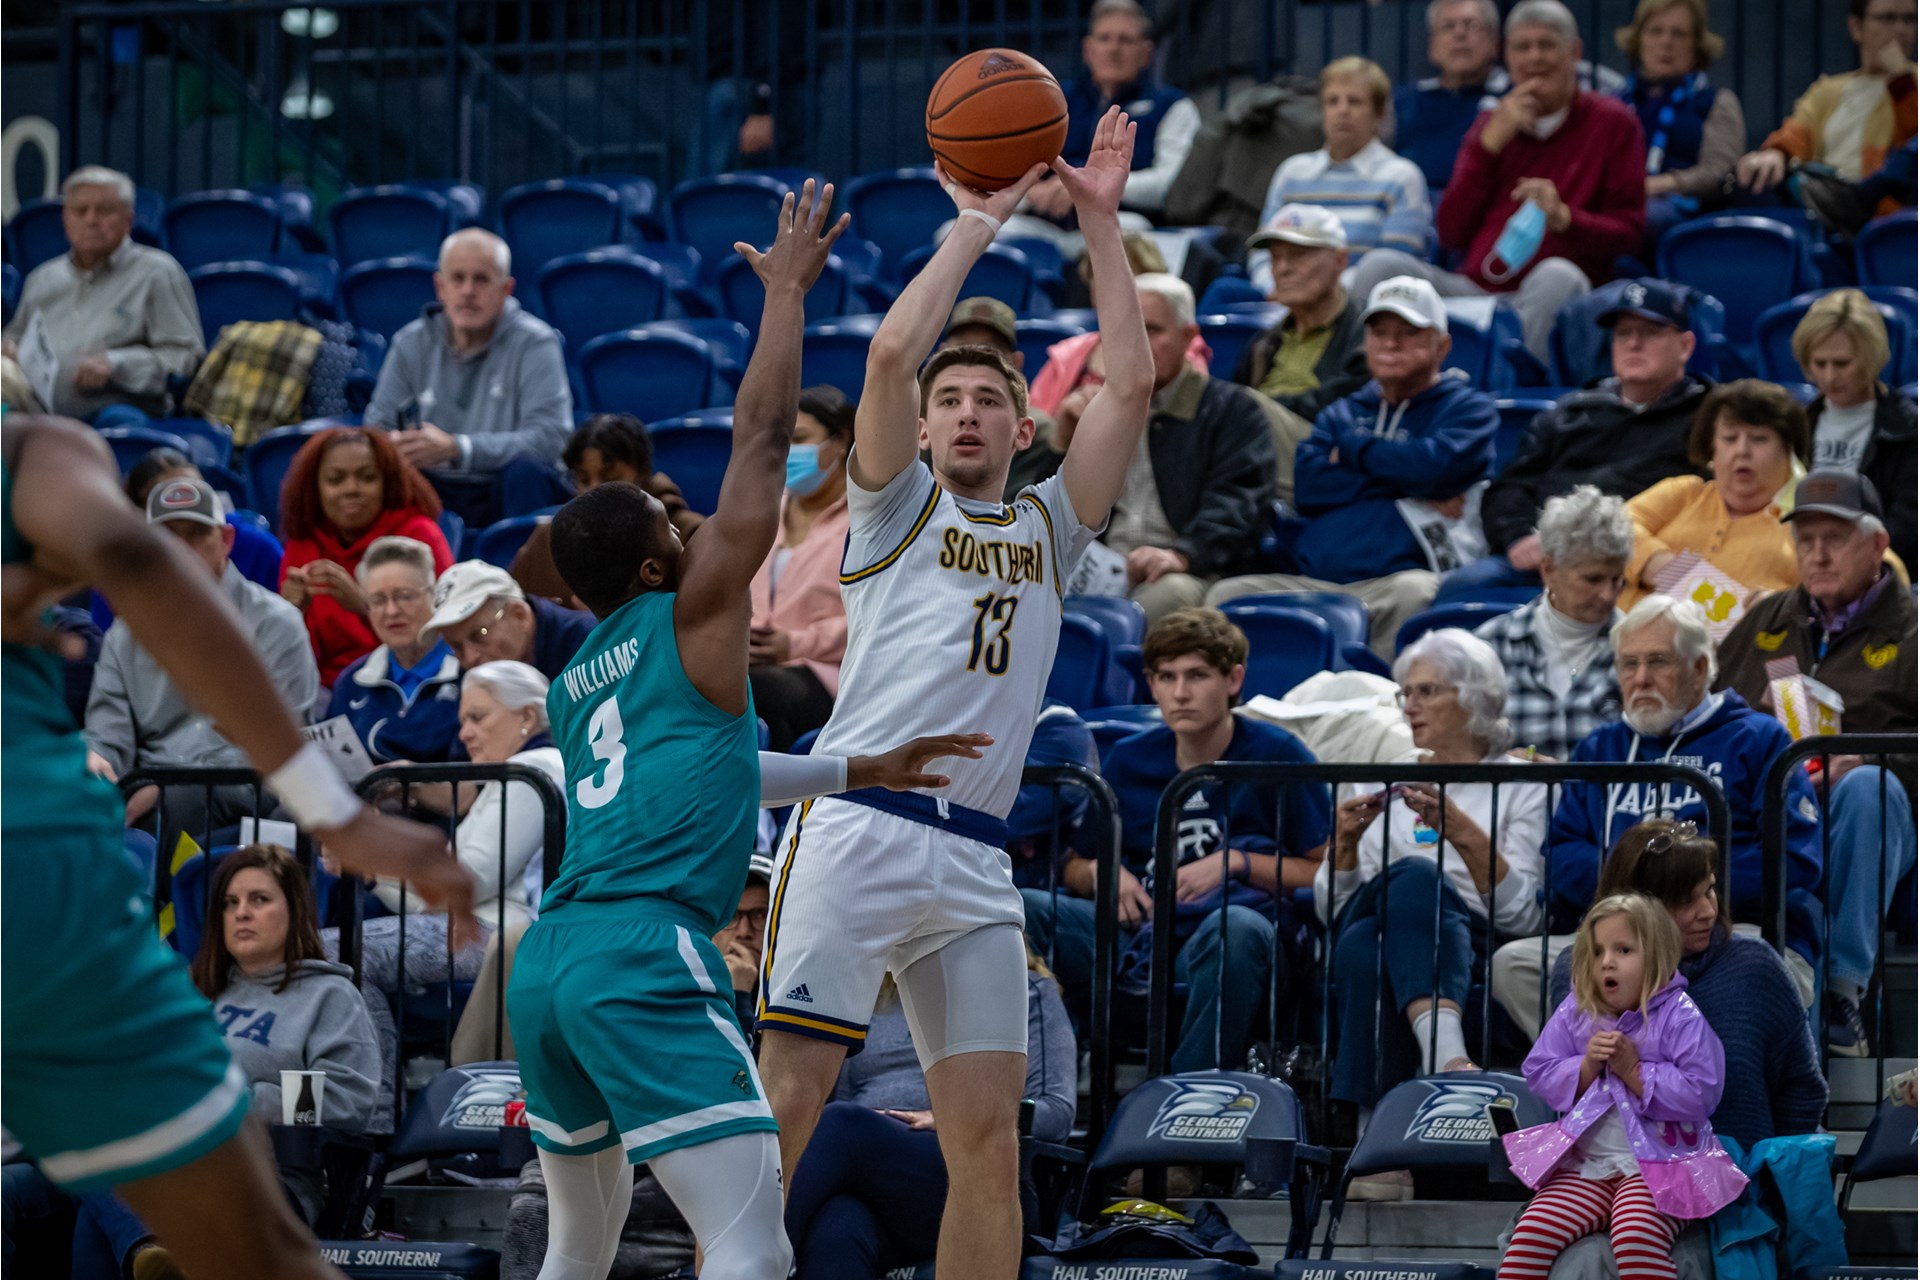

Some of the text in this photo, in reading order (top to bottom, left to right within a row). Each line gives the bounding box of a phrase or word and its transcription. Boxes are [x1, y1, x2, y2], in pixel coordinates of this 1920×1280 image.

[978, 63, 1026, 79] adidas
[966, 591, 1019, 677] 13
[563, 637, 639, 702] WILLIAMS
[576, 694, 628, 810] 3
[786, 993, 814, 1004] adidas
[1173, 1116, 1247, 1129] GEORGIA
[1166, 1126, 1241, 1138] SOUTHERN
[320, 1248, 442, 1267] HAIL SOUTHERN!
[1052, 1265, 1089, 1280] HAIL
